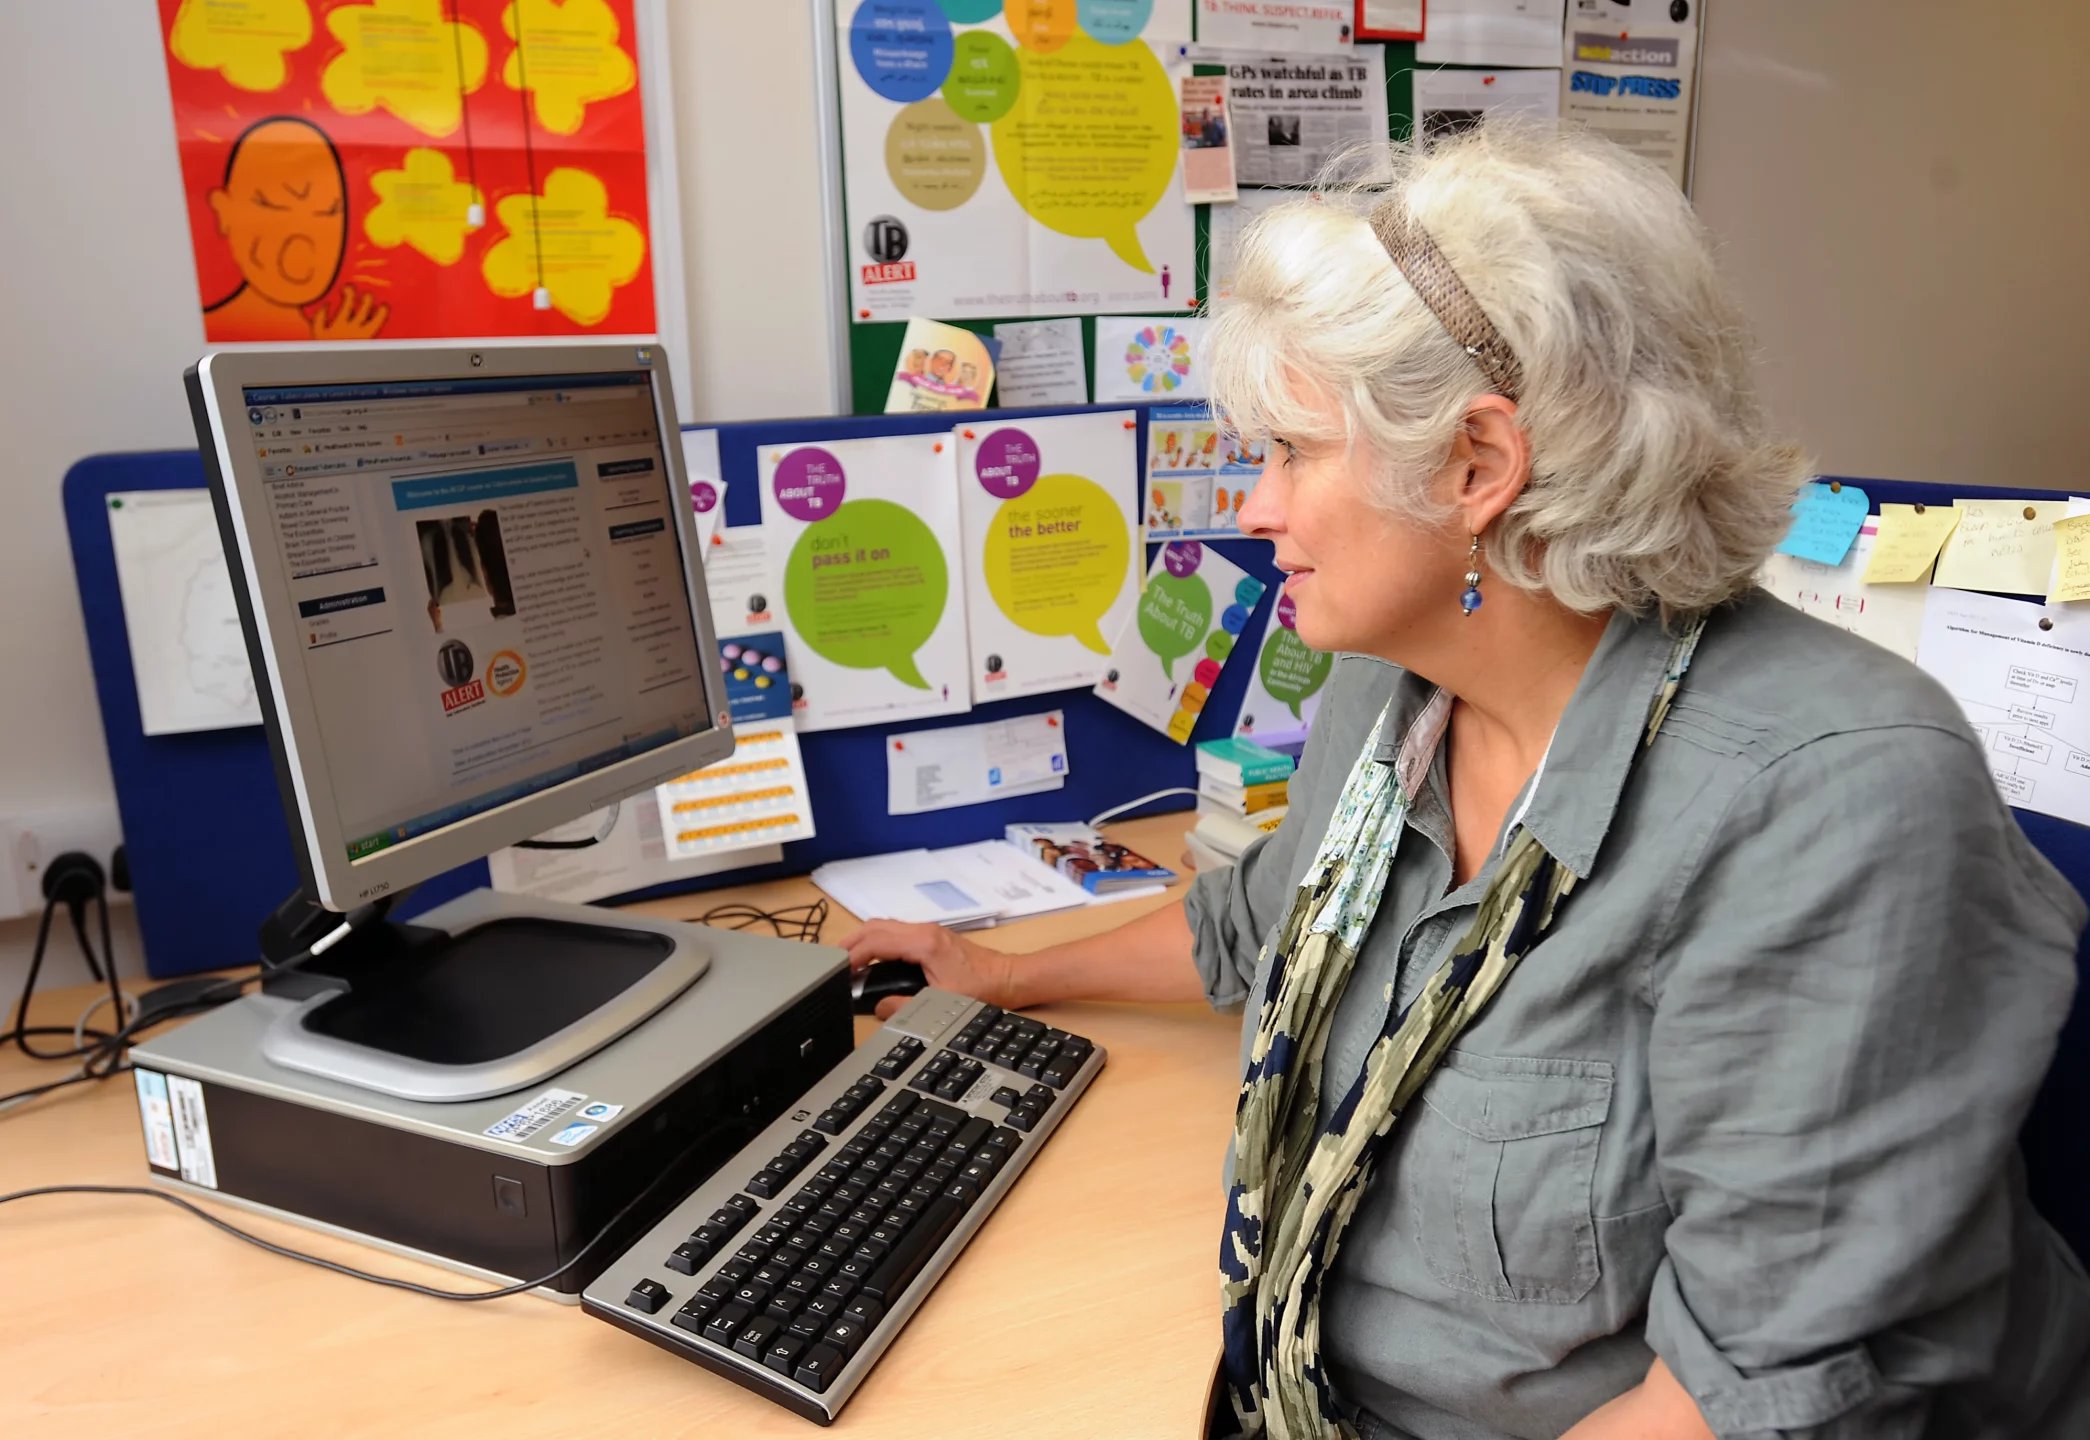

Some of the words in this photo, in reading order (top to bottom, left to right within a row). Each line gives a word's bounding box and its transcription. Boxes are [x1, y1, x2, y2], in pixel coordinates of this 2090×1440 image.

[1229, 66, 1256, 79] GPs
[1261, 65, 1323, 81] watchful
[1330, 69, 1343, 80] as
[1347, 67, 1367, 80] TB
[1232, 85, 1264, 98] rates
[1270, 84, 1282, 98] in
[1289, 88, 1317, 98] area
[1322, 84, 1361, 99] climb
[1570, 70, 1617, 95] STOP
[1618, 75, 1680, 98] PRESS
[868, 219, 908, 262] TB
[863, 264, 914, 283] ALERT
[1005, 443, 1023, 453] THE
[1005, 453, 1036, 464] TRUTH
[806, 463, 827, 474] THE
[980, 466, 1012, 478] ABOUT
[806, 473, 841, 485] TRUTH
[1006, 476, 1019, 487] TB
[779, 486, 815, 499] ABOUT
[807, 497, 823, 508] TB
[1008, 508, 1031, 523] the
[1036, 504, 1083, 520] sooner
[1009, 523, 1032, 538] the
[1037, 520, 1081, 536] better
[811, 534, 850, 550] don't
[812, 551, 851, 570] pass
[855, 548, 867, 562] it
[871, 547, 891, 561] on
[319, 594, 368, 610] Administration
[1153, 584, 1174, 609] The
[1174, 597, 1204, 628] Truth
[1144, 602, 1178, 632] About
[1180, 619, 1197, 641] TB
[1282, 629, 1300, 645] The
[1946, 624, 1970, 634] Algorithm
[1979, 630, 2010, 642] Management
[2017, 636, 2036, 646] Vitamin
[2041, 642, 2064, 653] deficiency
[2069, 648, 2084, 658] newly
[1276, 643, 1307, 661] About
[1309, 649, 1324, 665] TB
[439, 644, 473, 685] TB
[1273, 657, 1293, 669] and
[1294, 660, 1313, 674] HIV
[2012, 668, 2026, 676] Check
[1267, 676, 1303, 693] Community
[445, 681, 482, 709] ALERT
[2016, 708, 2033, 717] Review
[361, 836, 380, 850] start
